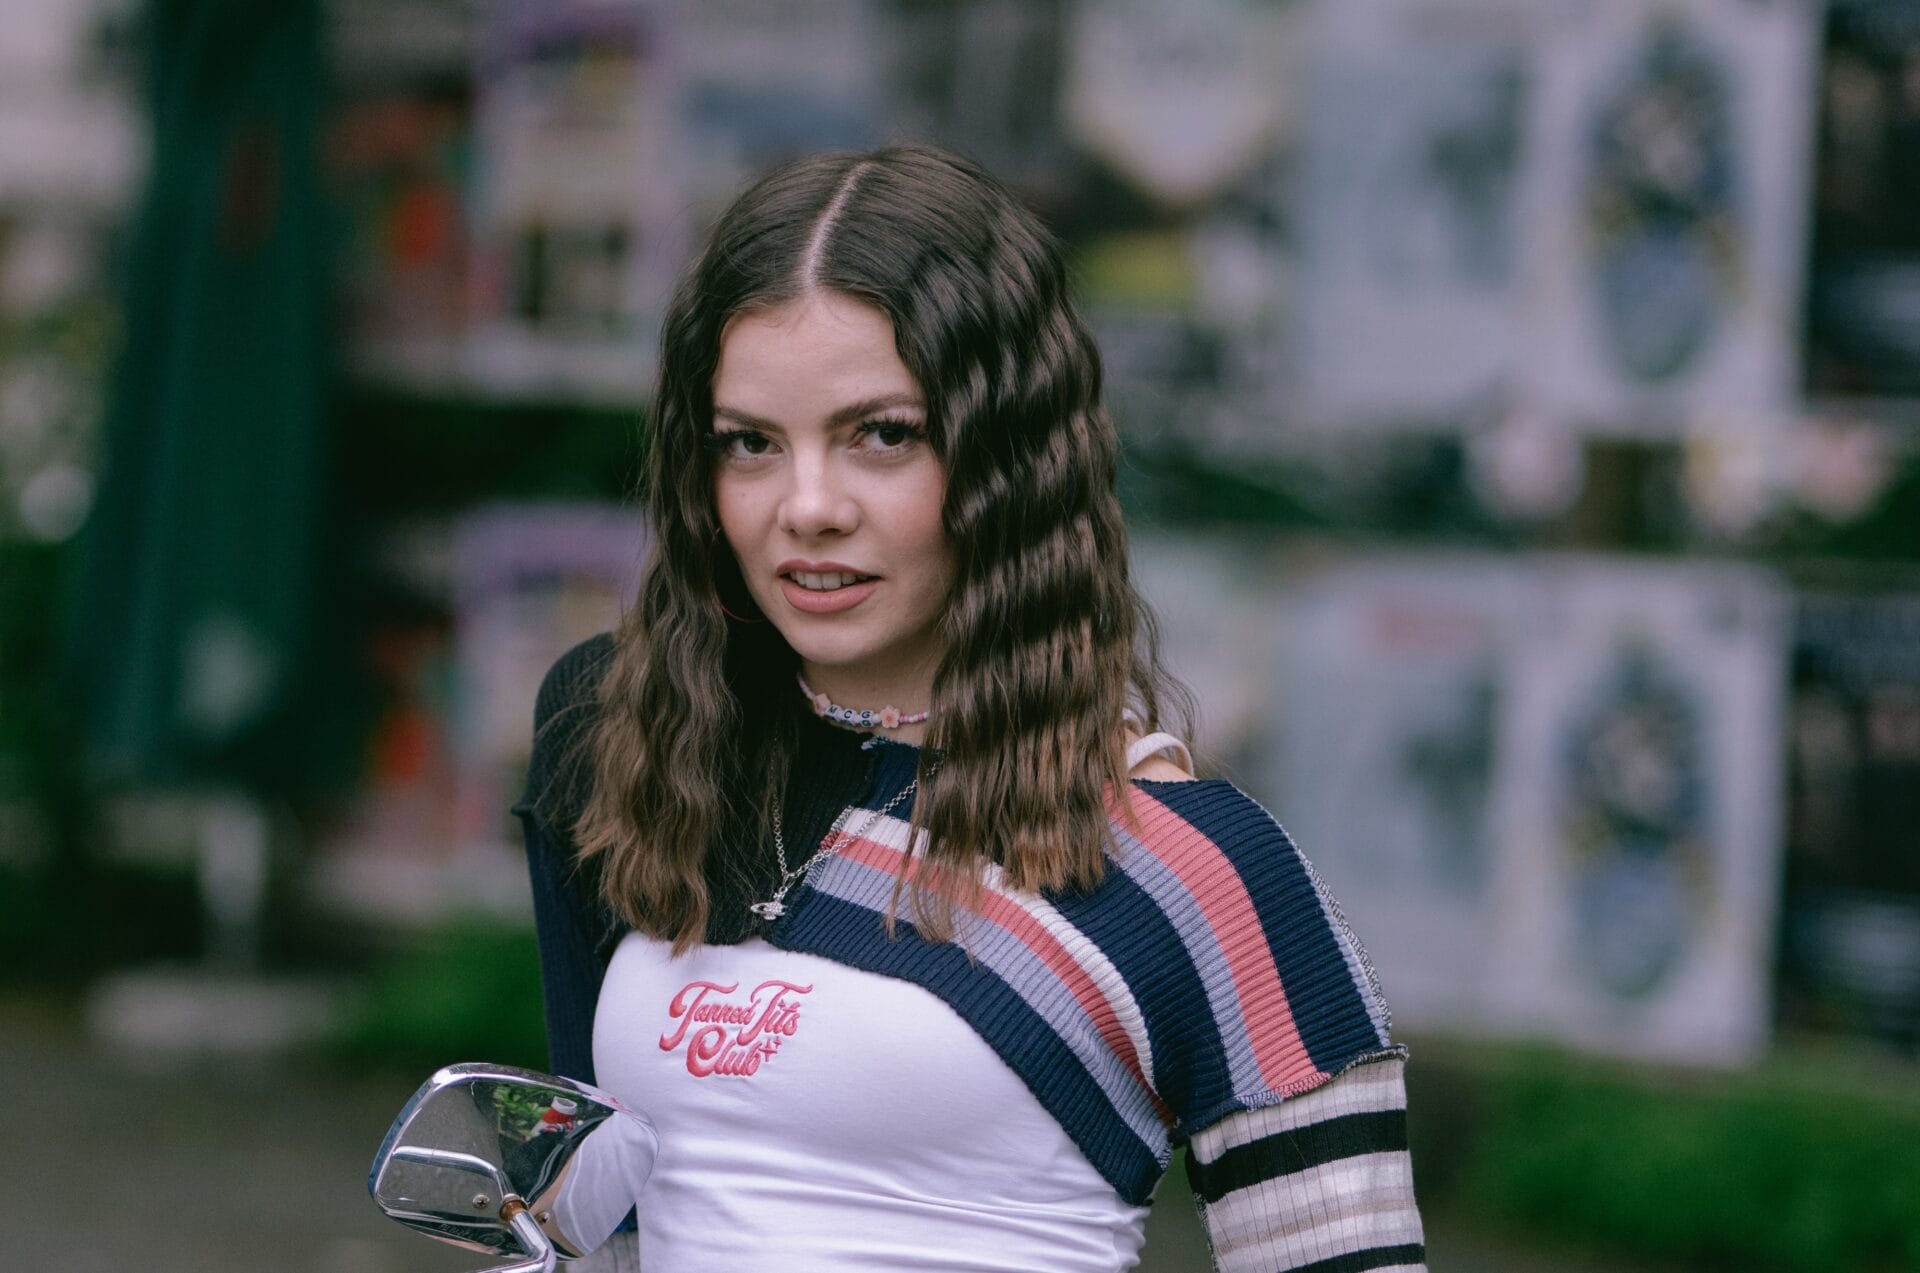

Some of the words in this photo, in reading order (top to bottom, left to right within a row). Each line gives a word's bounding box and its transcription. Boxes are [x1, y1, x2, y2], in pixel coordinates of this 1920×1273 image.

[659, 980, 761, 1051] Tanned
[737, 980, 813, 1046] Tits
[686, 1024, 762, 1077] Club
